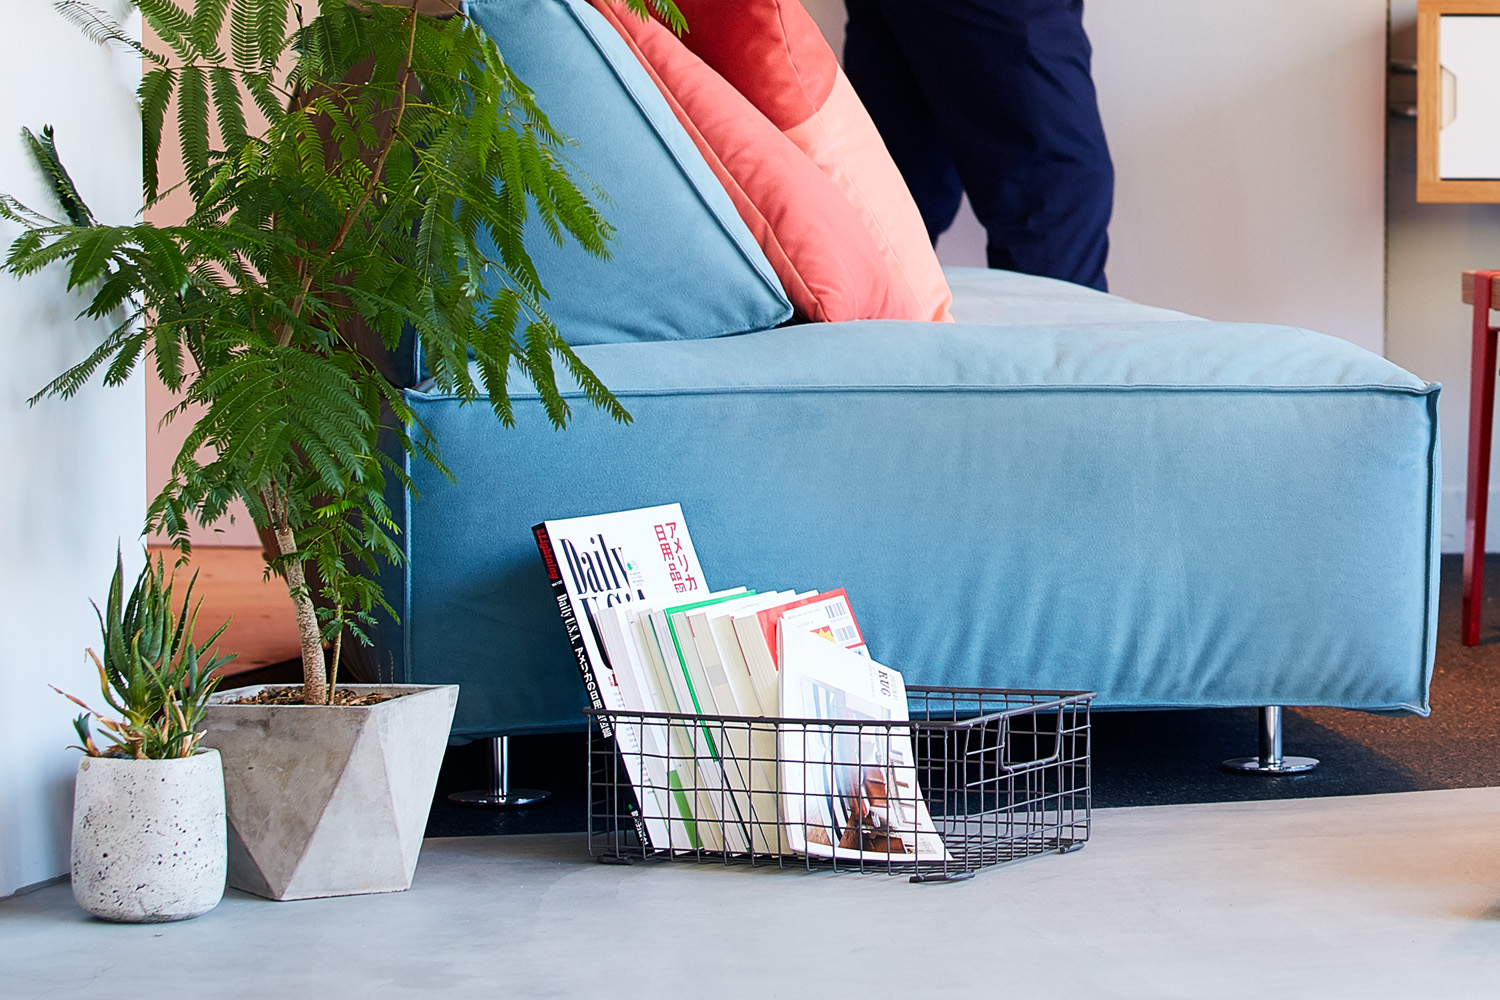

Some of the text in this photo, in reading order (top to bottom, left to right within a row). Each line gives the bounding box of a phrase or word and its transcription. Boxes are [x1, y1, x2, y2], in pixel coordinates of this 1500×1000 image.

[558, 533, 635, 602] Daily
[665, 521, 698, 592] アメリカ
[556, 593, 573, 618] Daily
[564, 616, 581, 645] U.S.A.
